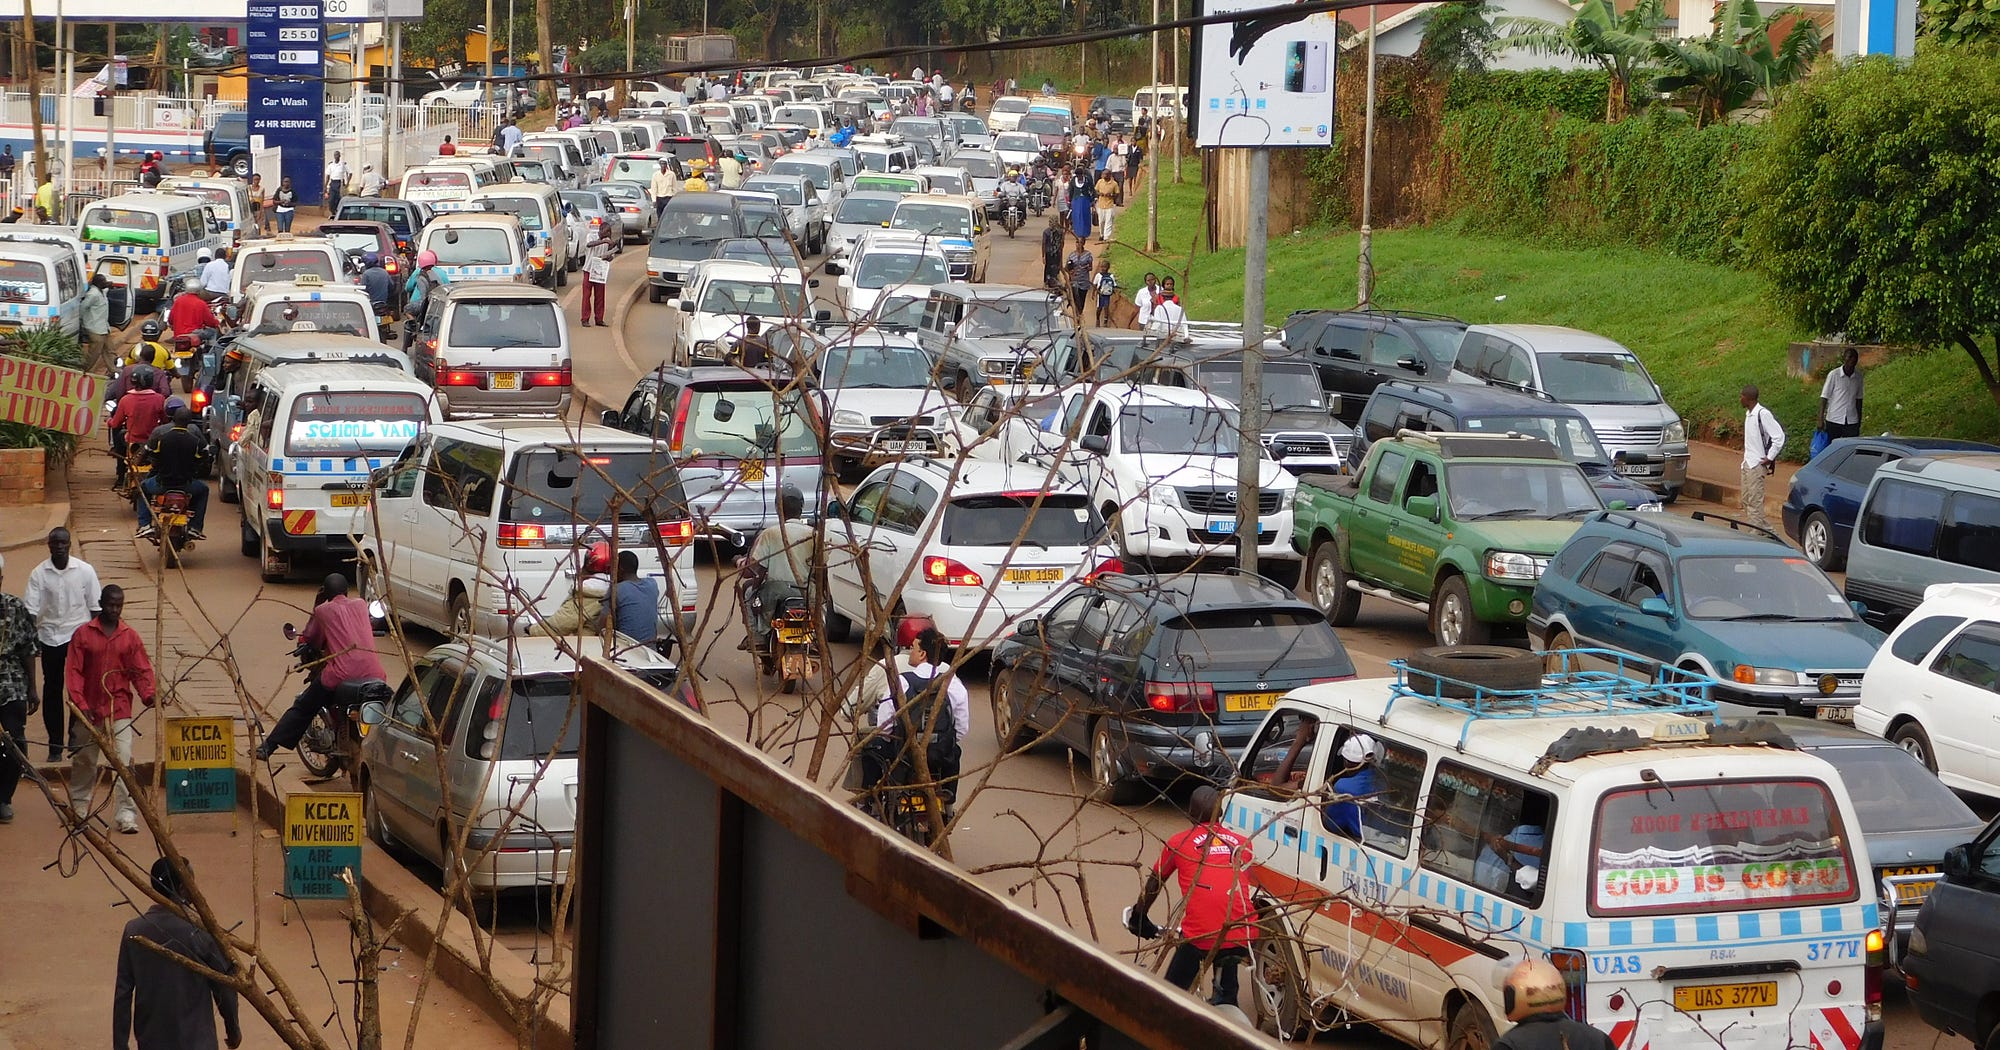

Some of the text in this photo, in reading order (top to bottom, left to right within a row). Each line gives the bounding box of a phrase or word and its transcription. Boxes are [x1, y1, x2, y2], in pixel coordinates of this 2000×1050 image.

[281, 8, 317, 17] 3300
[281, 30, 317, 39] 2550
[280, 52, 298, 61] 00
[262, 97, 308, 106] Car Wash
[254, 120, 316, 128] 24 HR SERVICE
[0, 357, 96, 401] PHOTO
[0, 390, 94, 436] TUDIO
[306, 424, 416, 437] SCHOOL VAN
[1218, 521, 1235, 531] UAR
[1012, 570, 1059, 580] UAR 115R
[1240, 695, 1260, 709] UAF
[1827, 708, 1847, 719] UAJ
[181, 725, 222, 741] KCCA
[1666, 722, 1698, 736] TAXI
[170, 745, 227, 761] NO VENDORS
[174, 782, 229, 797] ALLOWED
[304, 802, 350, 820] KCCA
[291, 824, 354, 842] NO VENDORS
[308, 849, 333, 863] ARE
[293, 865, 351, 881] ALLOW
[1605, 858, 1840, 897] GOD IS GOOD
[302, 883, 333, 894] HERE
[1806, 940, 1861, 961] 377V
[1593, 955, 1642, 974] UAS
[1375, 969, 1408, 1000] YESU
[1695, 985, 1769, 1007] UAS 377V
